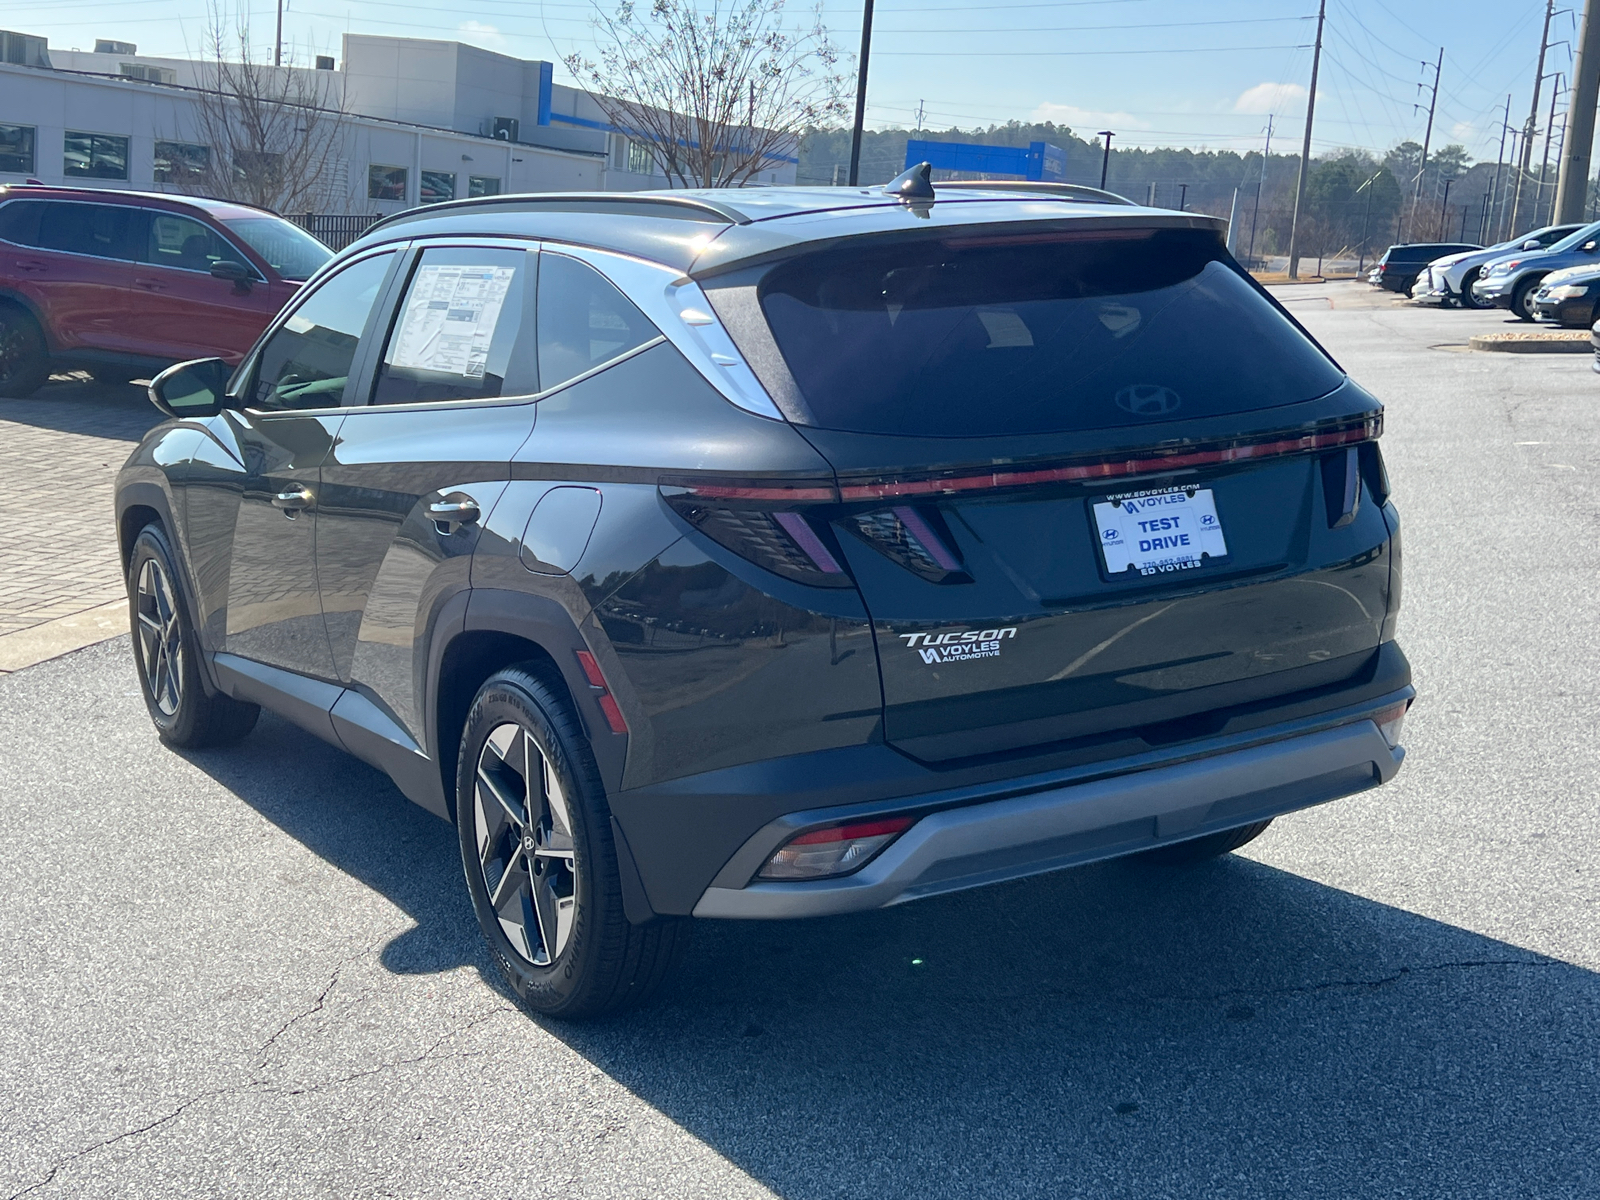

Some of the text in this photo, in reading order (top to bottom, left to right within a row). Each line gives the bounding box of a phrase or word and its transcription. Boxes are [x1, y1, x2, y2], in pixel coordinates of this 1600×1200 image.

[1106, 483, 1200, 501] WWW.EDVOYLES.COM
[1137, 493, 1186, 508] VOYLES
[1138, 516, 1180, 533] TEST
[1138, 533, 1191, 553] DRIVE
[1140, 559, 1202, 576] ED VOYLES
[899, 627, 1017, 647] TUCSON
[940, 640, 1000, 656] VOYLES
[942, 649, 1000, 663] AUTOMOTIVE
[564, 903, 586, 980] KUMHO
